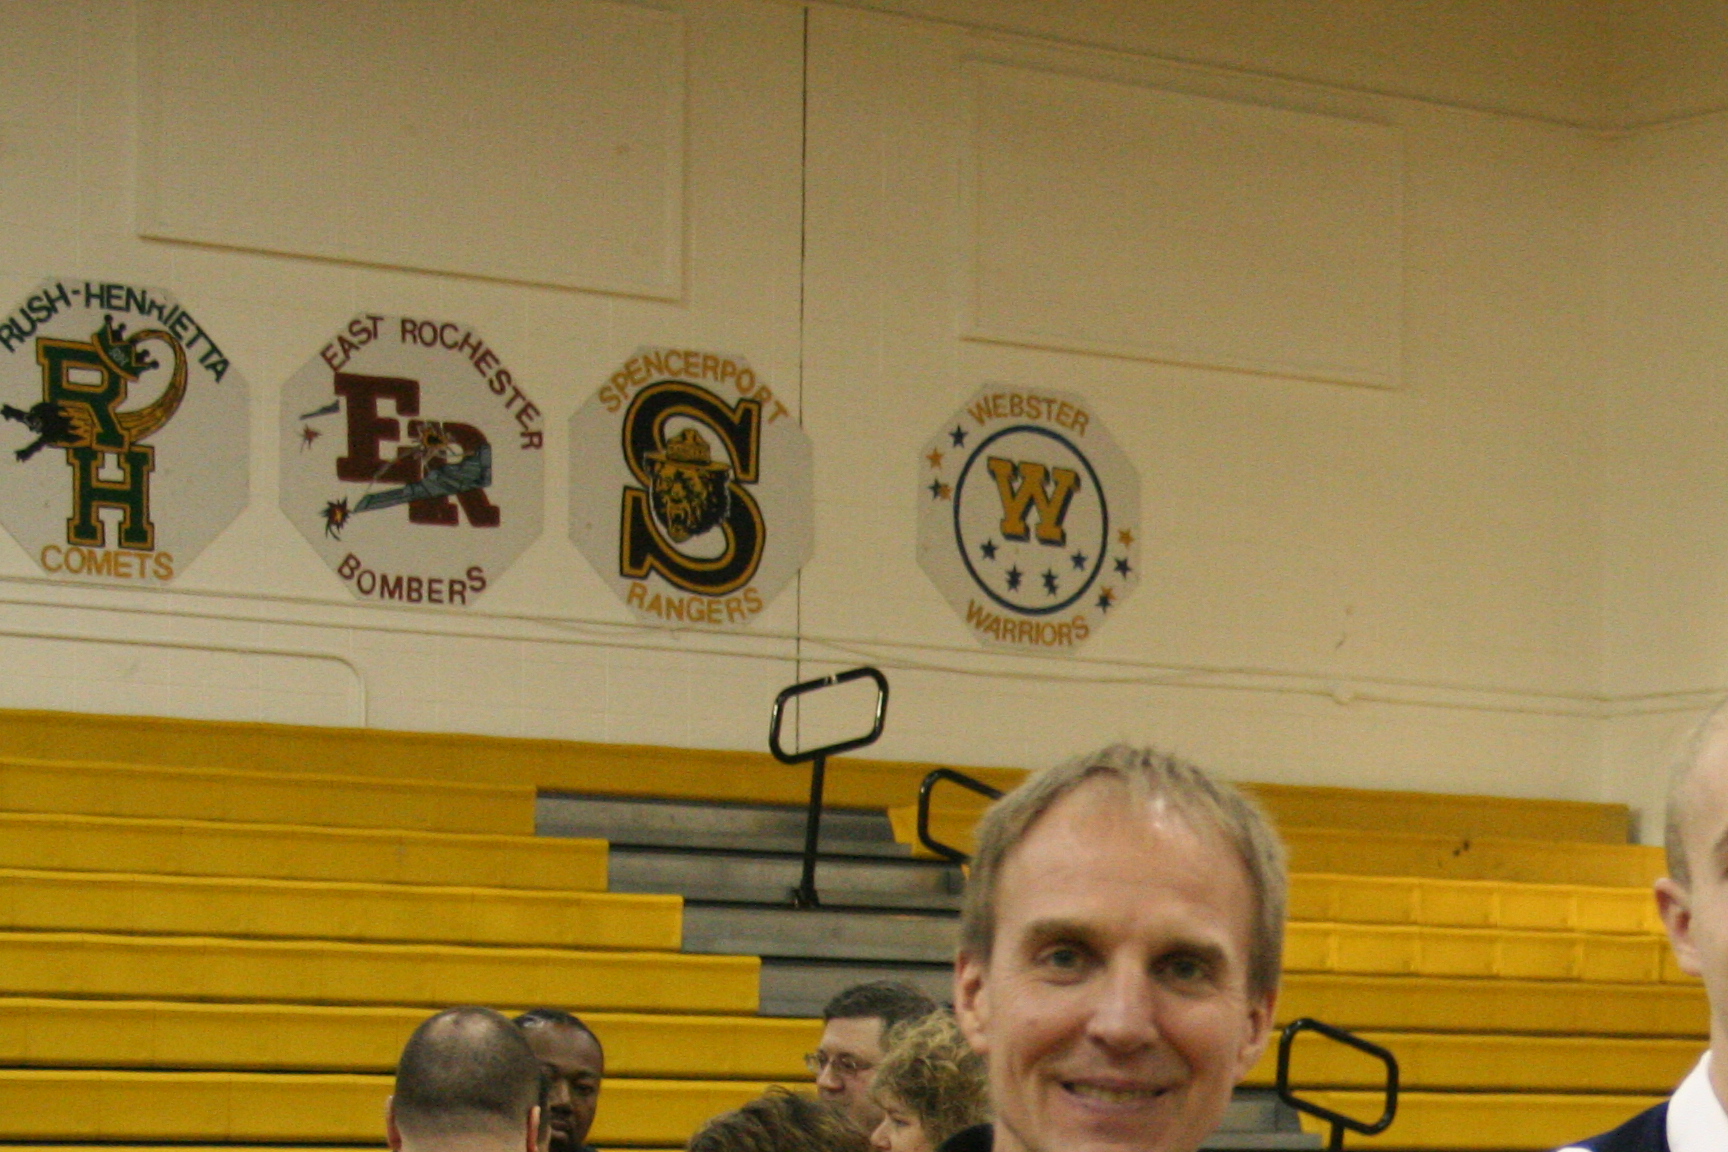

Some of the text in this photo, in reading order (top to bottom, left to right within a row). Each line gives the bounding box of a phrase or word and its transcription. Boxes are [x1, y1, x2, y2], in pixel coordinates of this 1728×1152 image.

[0, 281, 230, 384] RUSH-HENRIETTA
[320, 315, 543, 451] EAST ROCHESTER
[600, 349, 788, 425] SPENCERPORT
[967, 393, 1090, 437] WEBSTER
[987, 456, 1081, 547] W
[41, 544, 174, 581] COMETS
[337, 553, 487, 605] BOMBERS
[627, 582, 764, 625] RANGERS
[965, 599, 1090, 646] WARRIORS
